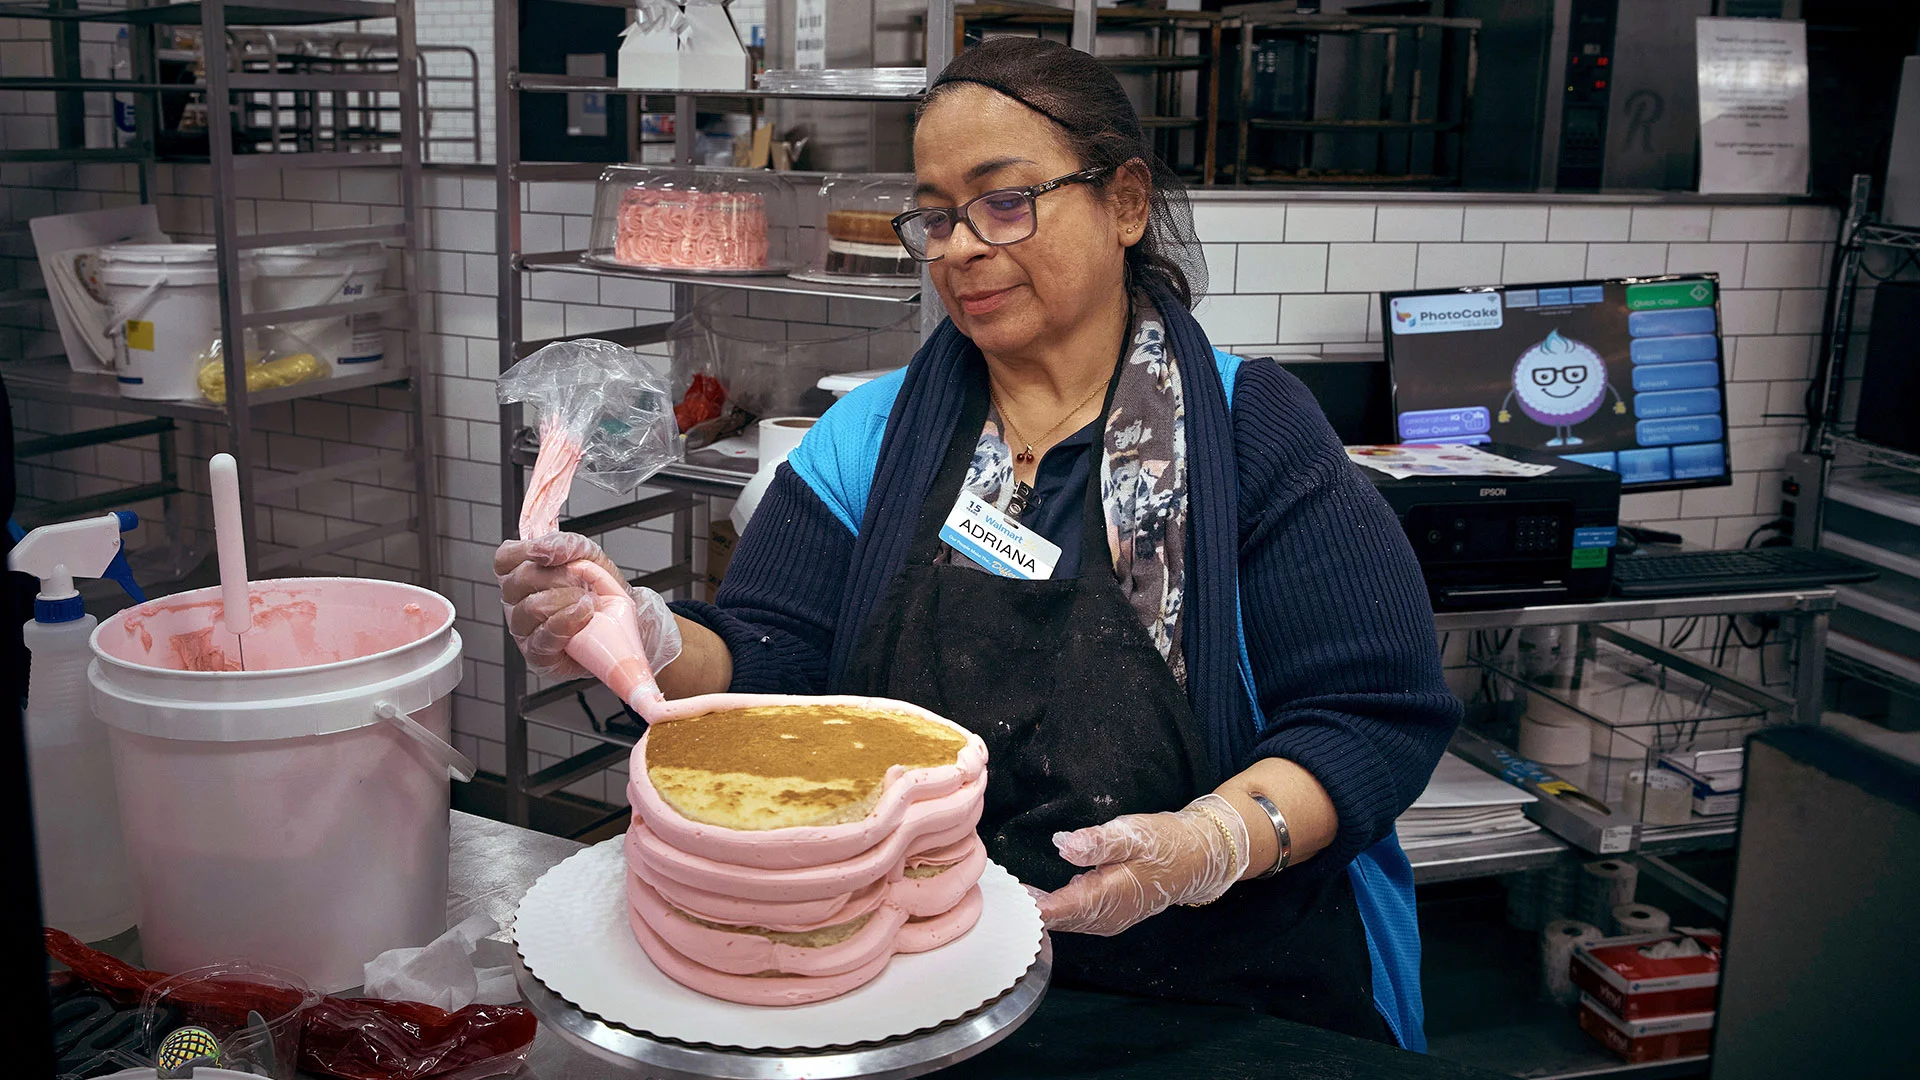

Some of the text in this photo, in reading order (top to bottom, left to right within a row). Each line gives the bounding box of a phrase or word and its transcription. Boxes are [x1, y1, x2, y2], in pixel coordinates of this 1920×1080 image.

[1420, 308, 1498, 321] PhotoCake
[1480, 488, 1507, 496] EPSON
[970, 501, 982, 512] 15
[985, 515, 1024, 544] Walmart
[959, 519, 1035, 573] ADRIANA
